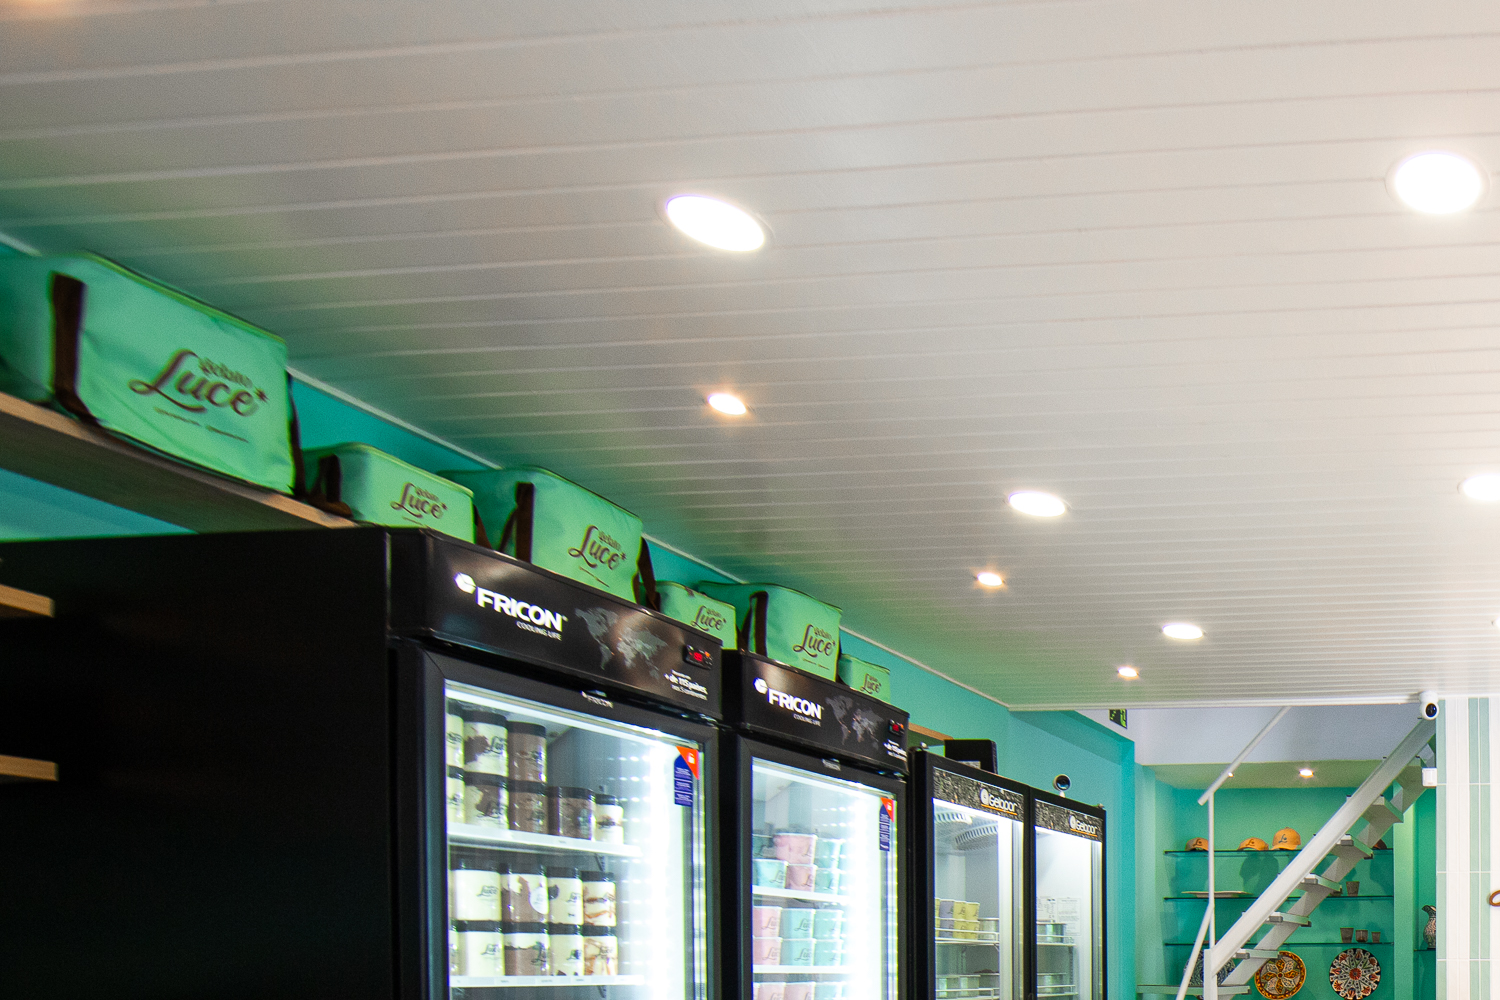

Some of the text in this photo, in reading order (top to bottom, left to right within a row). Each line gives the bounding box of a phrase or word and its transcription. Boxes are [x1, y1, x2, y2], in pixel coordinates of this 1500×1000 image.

[127, 348, 259, 417] Luce
[390, 481, 443, 519] Luce
[567, 524, 619, 570] Luce
[475, 586, 563, 633] FRICON
[691, 604, 724, 631] Luce
[792, 623, 833, 657] Luce
[767, 688, 822, 720] FRICON
